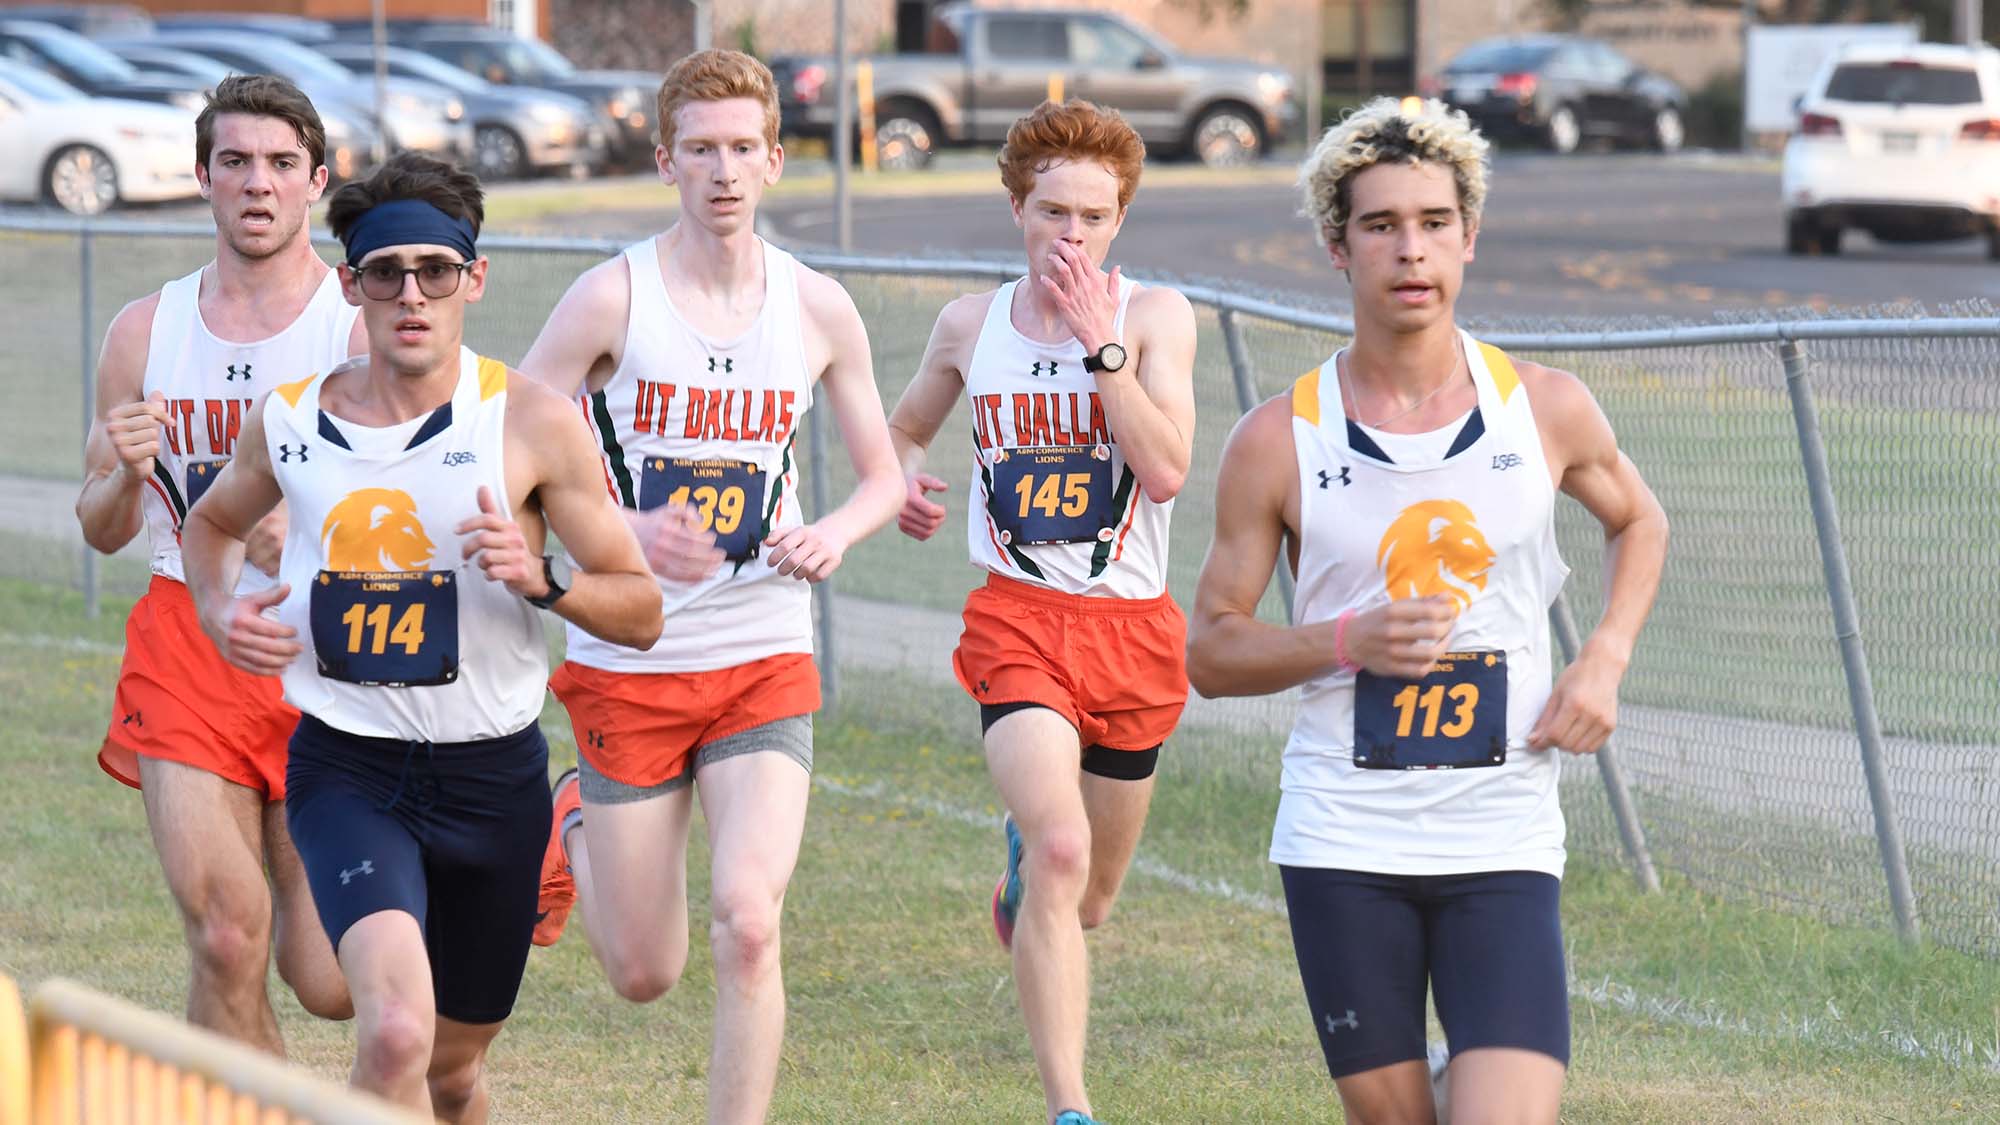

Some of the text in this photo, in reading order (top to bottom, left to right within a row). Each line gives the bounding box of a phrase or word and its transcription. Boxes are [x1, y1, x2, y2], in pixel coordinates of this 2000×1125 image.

[633, 379, 795, 443] UT DALLAS
[973, 392, 1117, 449] UT DALLA
[1035, 455, 1065, 464] LIONS
[1015, 472, 1091, 519] 145
[362, 582, 400, 592] LIONS
[342, 602, 426, 655] 114
[1392, 682, 1480, 738] 113
